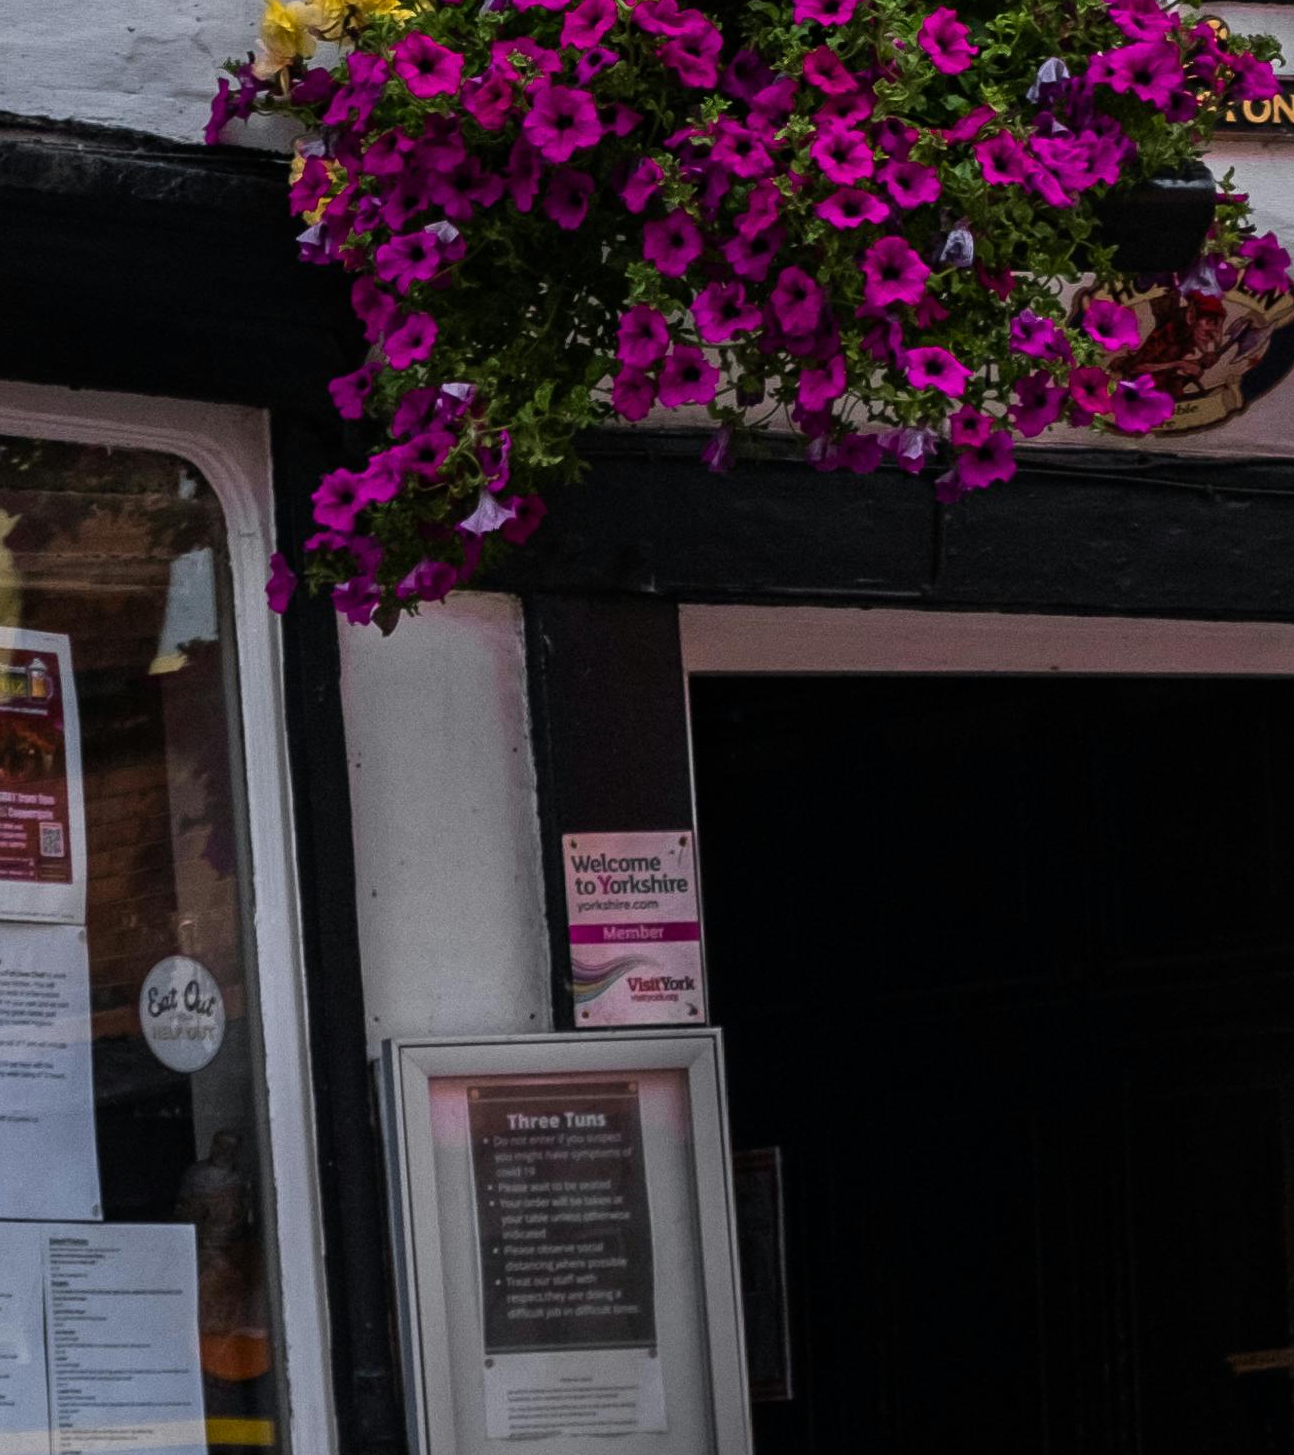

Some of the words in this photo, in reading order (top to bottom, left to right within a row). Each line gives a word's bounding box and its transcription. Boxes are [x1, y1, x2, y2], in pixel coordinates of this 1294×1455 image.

[571, 853, 661, 873] Welcome
[575, 877, 596, 895] to
[597, 874, 688, 895] Yorkshire
[577, 899, 659, 913] yorkshire.com
[603, 924, 666, 941] Member
[148, 987, 178, 1018] Eat
[184, 980, 215, 1017] Out
[507, 1113, 560, 1130] Three
[563, 1111, 606, 1128] Tuns
